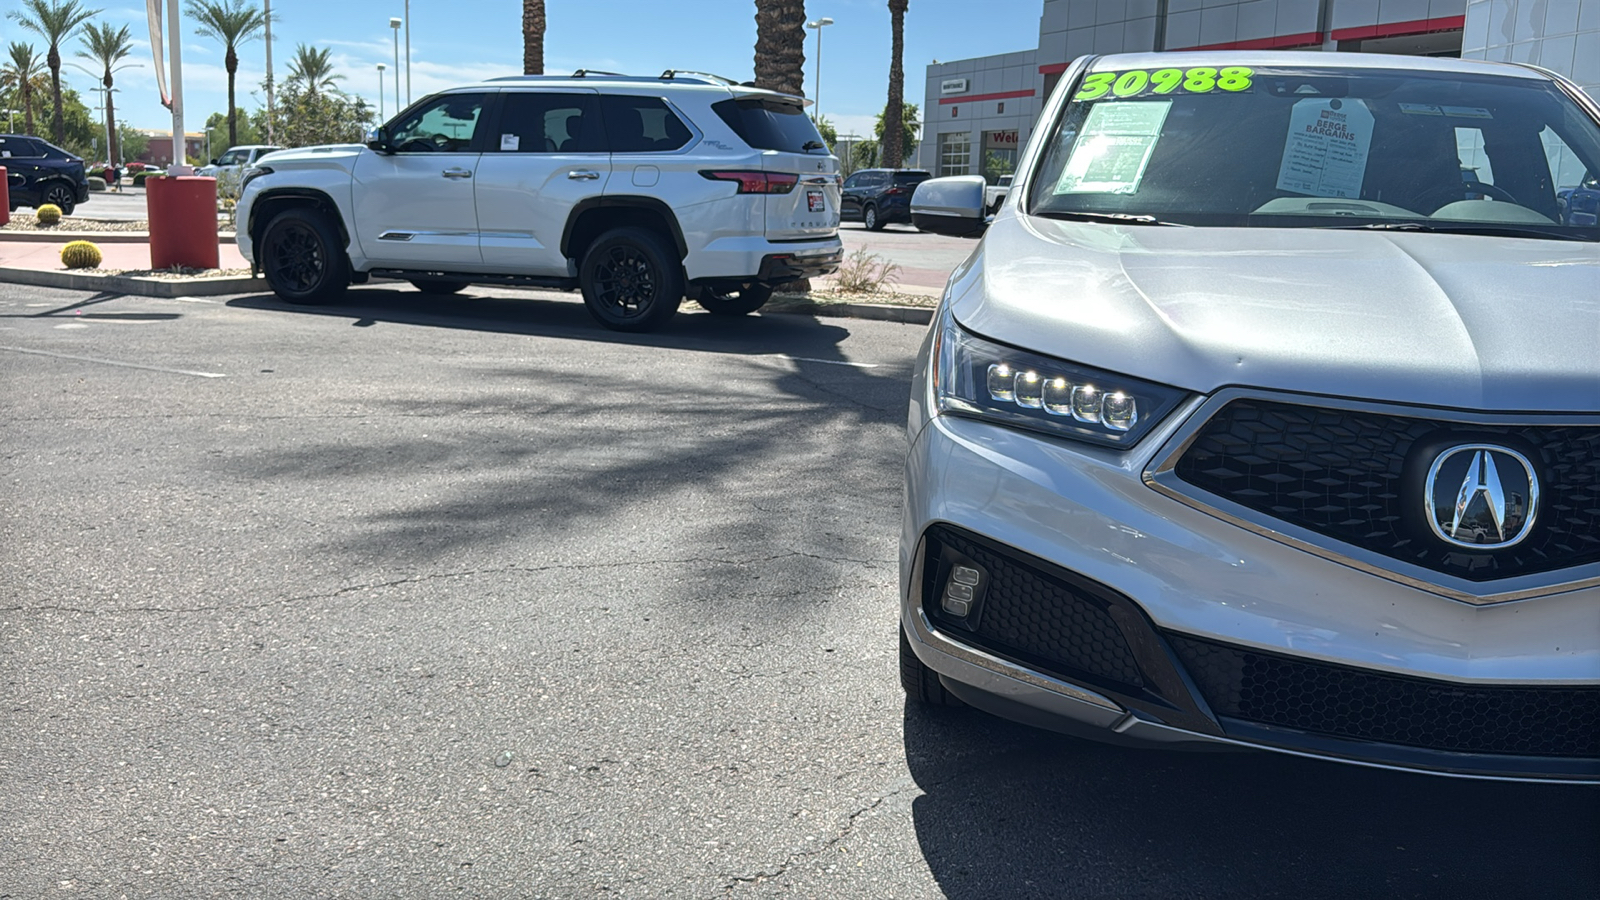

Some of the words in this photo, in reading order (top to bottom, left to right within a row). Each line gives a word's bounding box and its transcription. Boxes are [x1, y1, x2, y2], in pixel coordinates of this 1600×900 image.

[1074, 66, 1254, 100] 30988
[1317, 119, 1347, 131] BERGE
[993, 132, 1018, 143] Wel
[1306, 125, 1355, 141] BARGAINS
